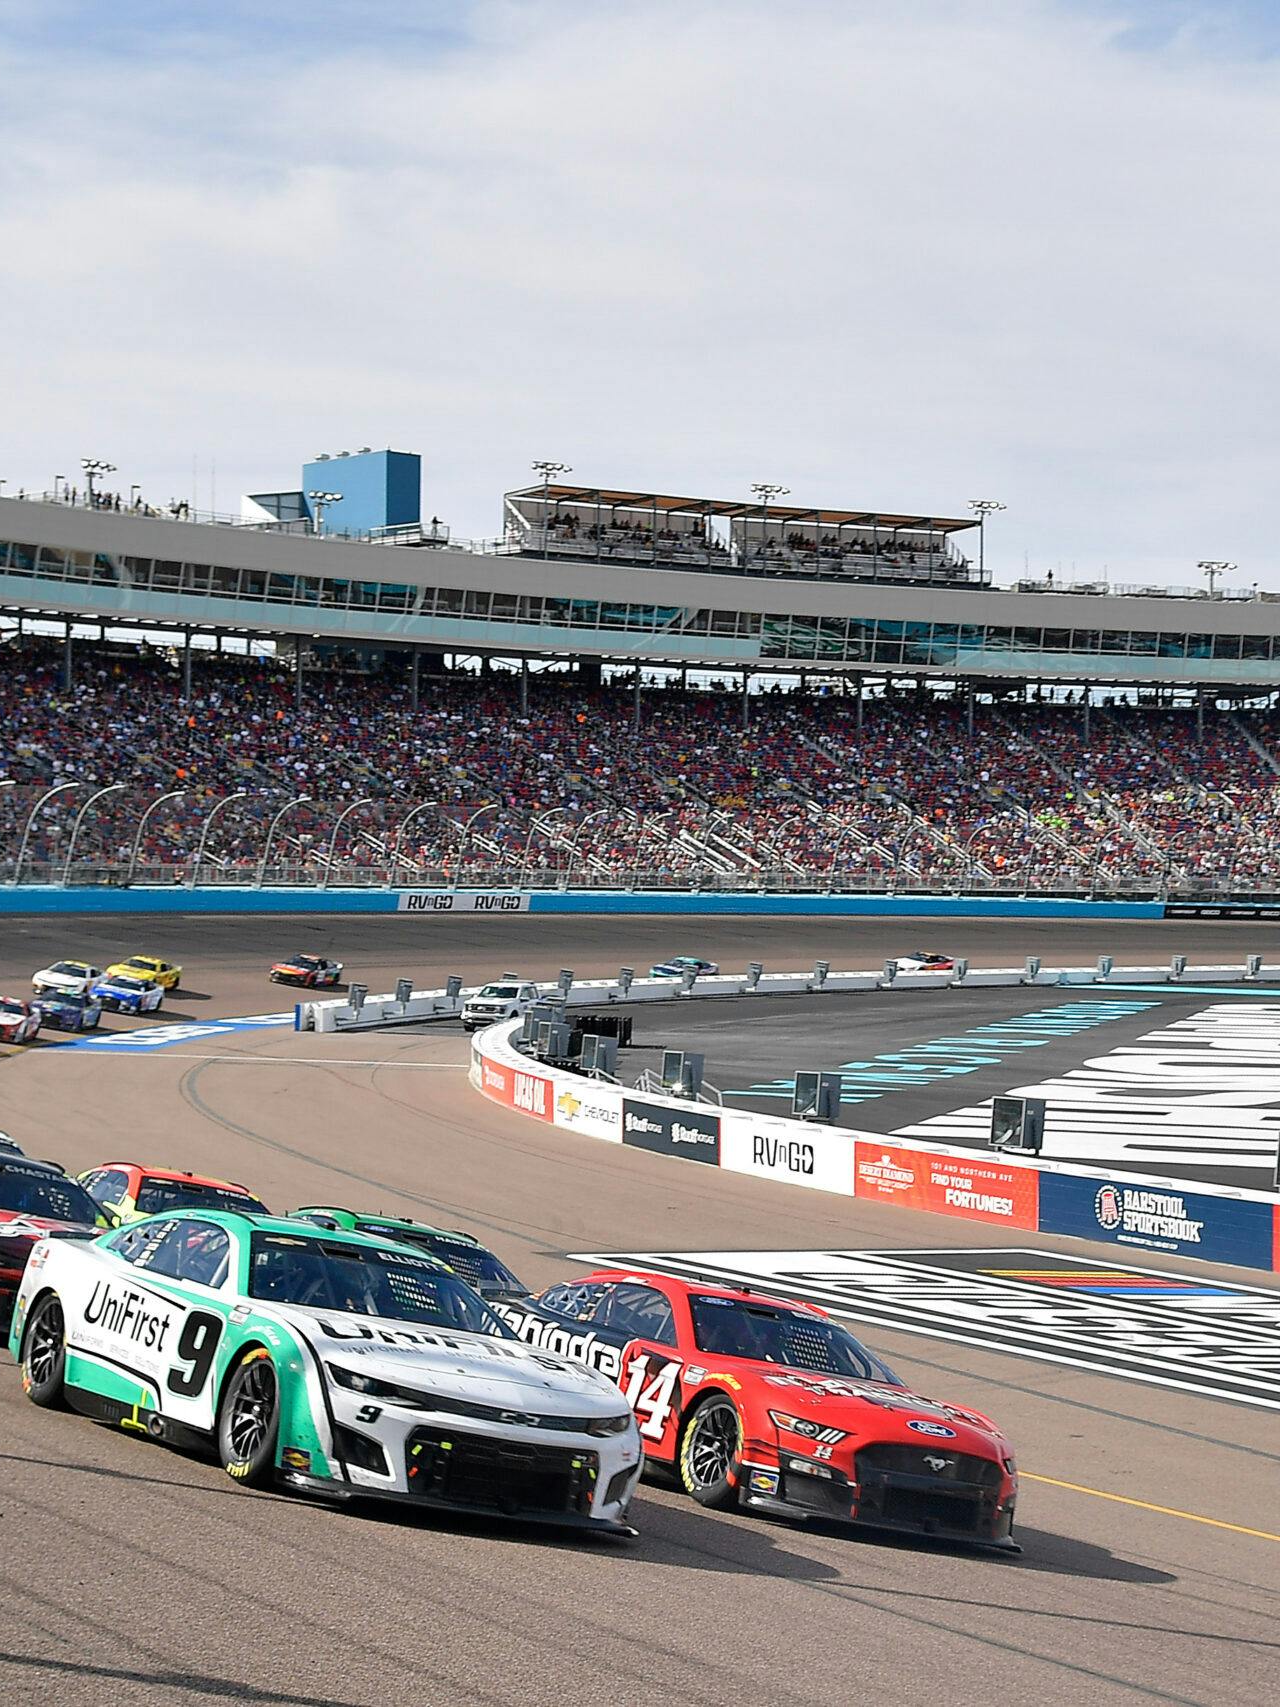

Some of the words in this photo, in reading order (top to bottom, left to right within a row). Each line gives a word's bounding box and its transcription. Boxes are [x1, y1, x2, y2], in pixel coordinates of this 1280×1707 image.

[5, 1164, 66, 1182] CHASTA
[943, 1164, 958, 1172] AND
[931, 1173, 949, 1186] FIND
[950, 1176, 972, 1190] YOUR
[945, 1189, 1013, 1216] FORTUNES!
[1123, 1190, 1186, 1218] BARSTOOL
[1123, 1211, 1201, 1242] SPORTSBOOK
[434, 1236, 478, 1250] HARVI
[377, 1252, 440, 1271] ELLIOTT
[84, 1281, 170, 1352] UniFirst
[167, 1310, 224, 1398] 9
[625, 1354, 683, 1440] 14
[355, 1405, 383, 1423] 9
[812, 1445, 833, 1460] 14
